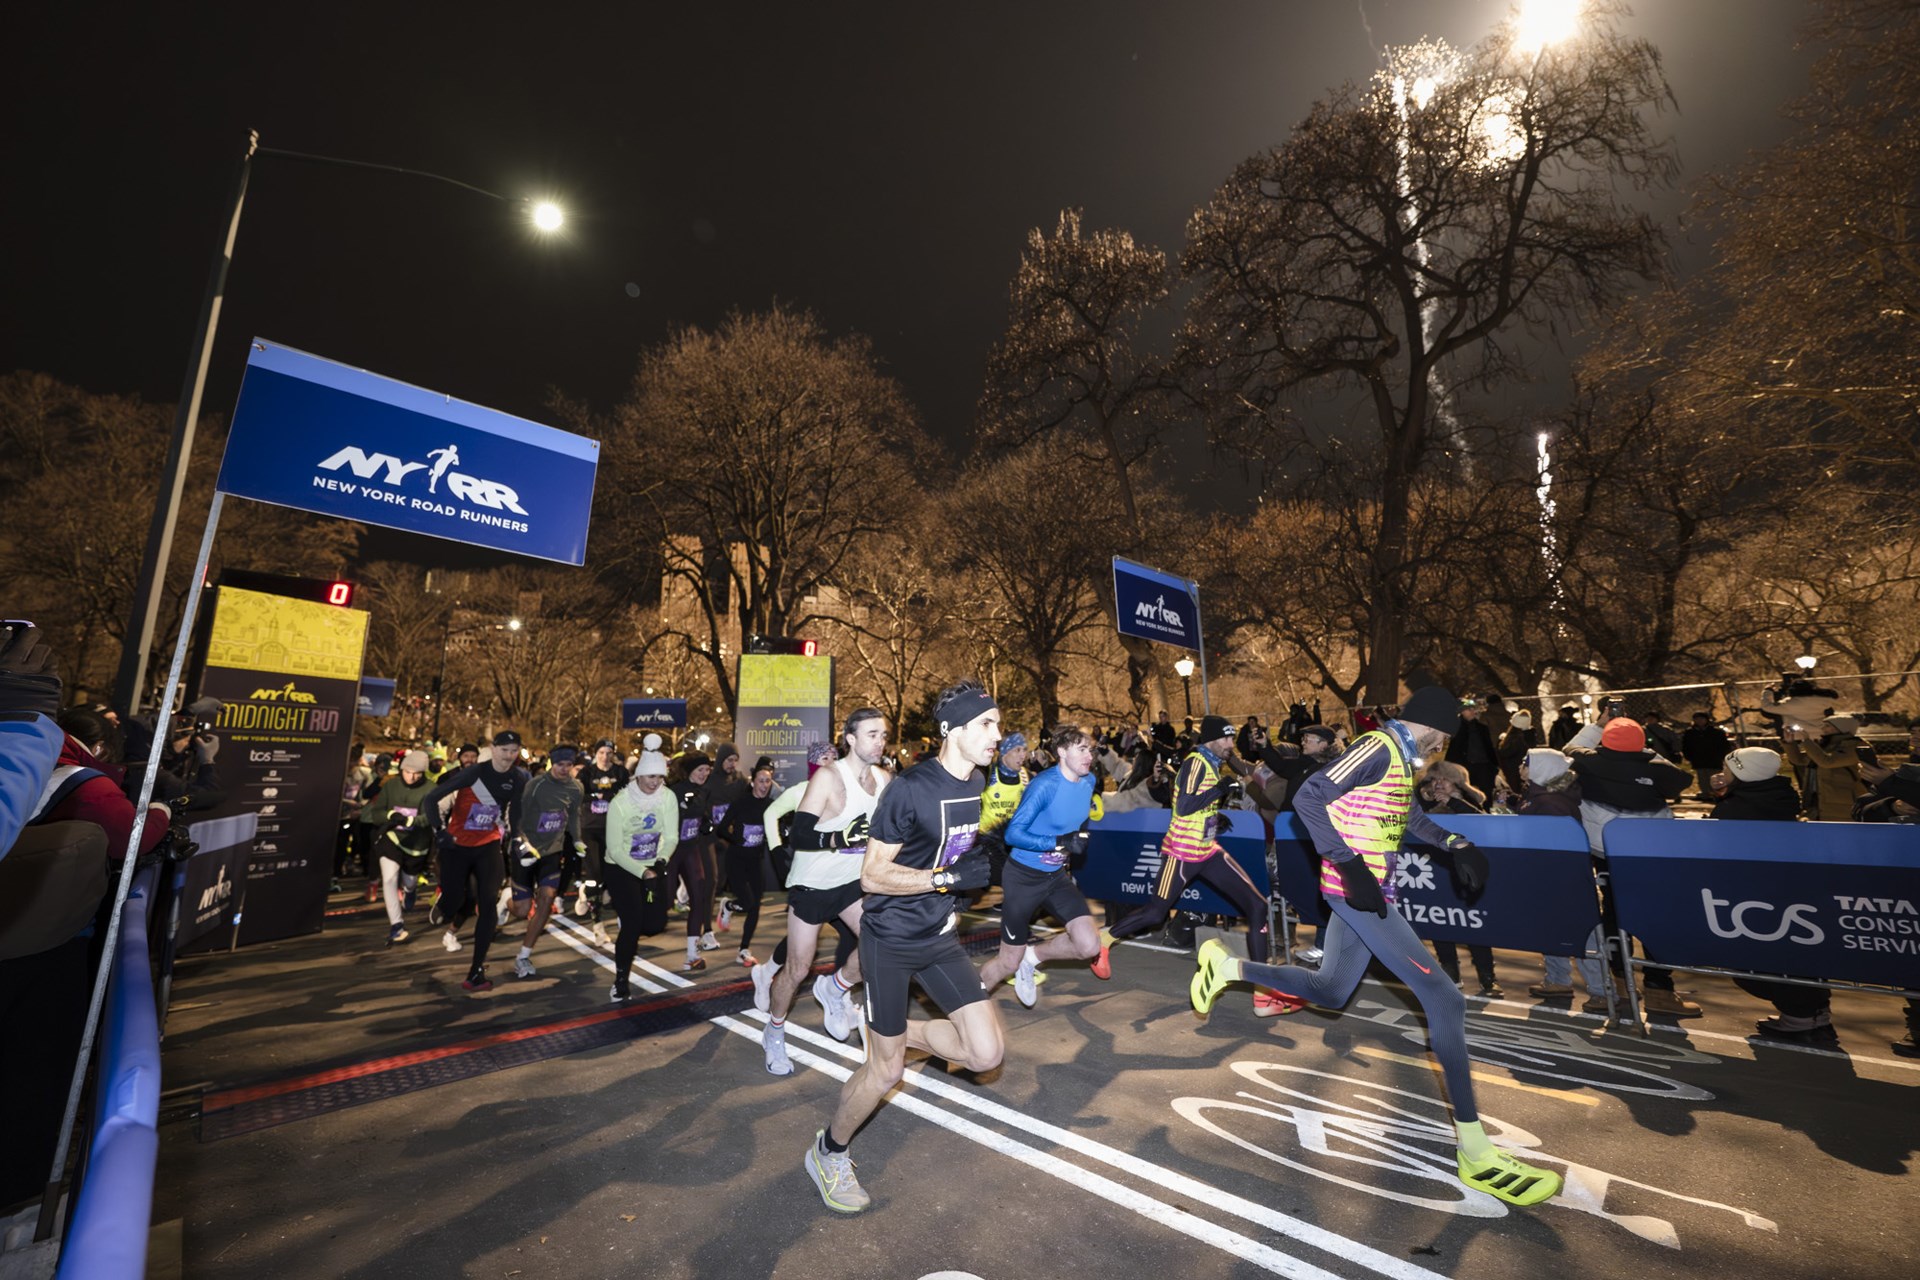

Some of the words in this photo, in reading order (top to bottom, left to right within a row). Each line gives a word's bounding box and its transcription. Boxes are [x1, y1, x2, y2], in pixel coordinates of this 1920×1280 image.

[317, 445, 530, 517] NYRR
[313, 475, 356, 495] NEW
[360, 482, 406, 506] YORK
[411, 498, 456, 517] ROAD
[460, 509, 529, 533] RUNNERS
[329, 583, 350, 606] 0
[1135, 596, 1184, 628] NYRR
[1135, 619, 1146, 627] NEW
[1146, 621, 1157, 630] YORK
[1157, 624, 1168, 633] ROAD
[804, 641, 816, 657] 0
[250, 683, 318, 704] NYRR
[215, 703, 310, 731] MIDNIGHT
[309, 709, 339, 732] RUN
[746, 730, 798, 746] MIDNIGHT
[250, 750, 271, 762] tcs
[1121, 882, 1146, 895] new
[1701, 887, 1825, 945] tcs
[1833, 895, 1919, 916] TATA
[1842, 934, 1920, 955] SERVI
